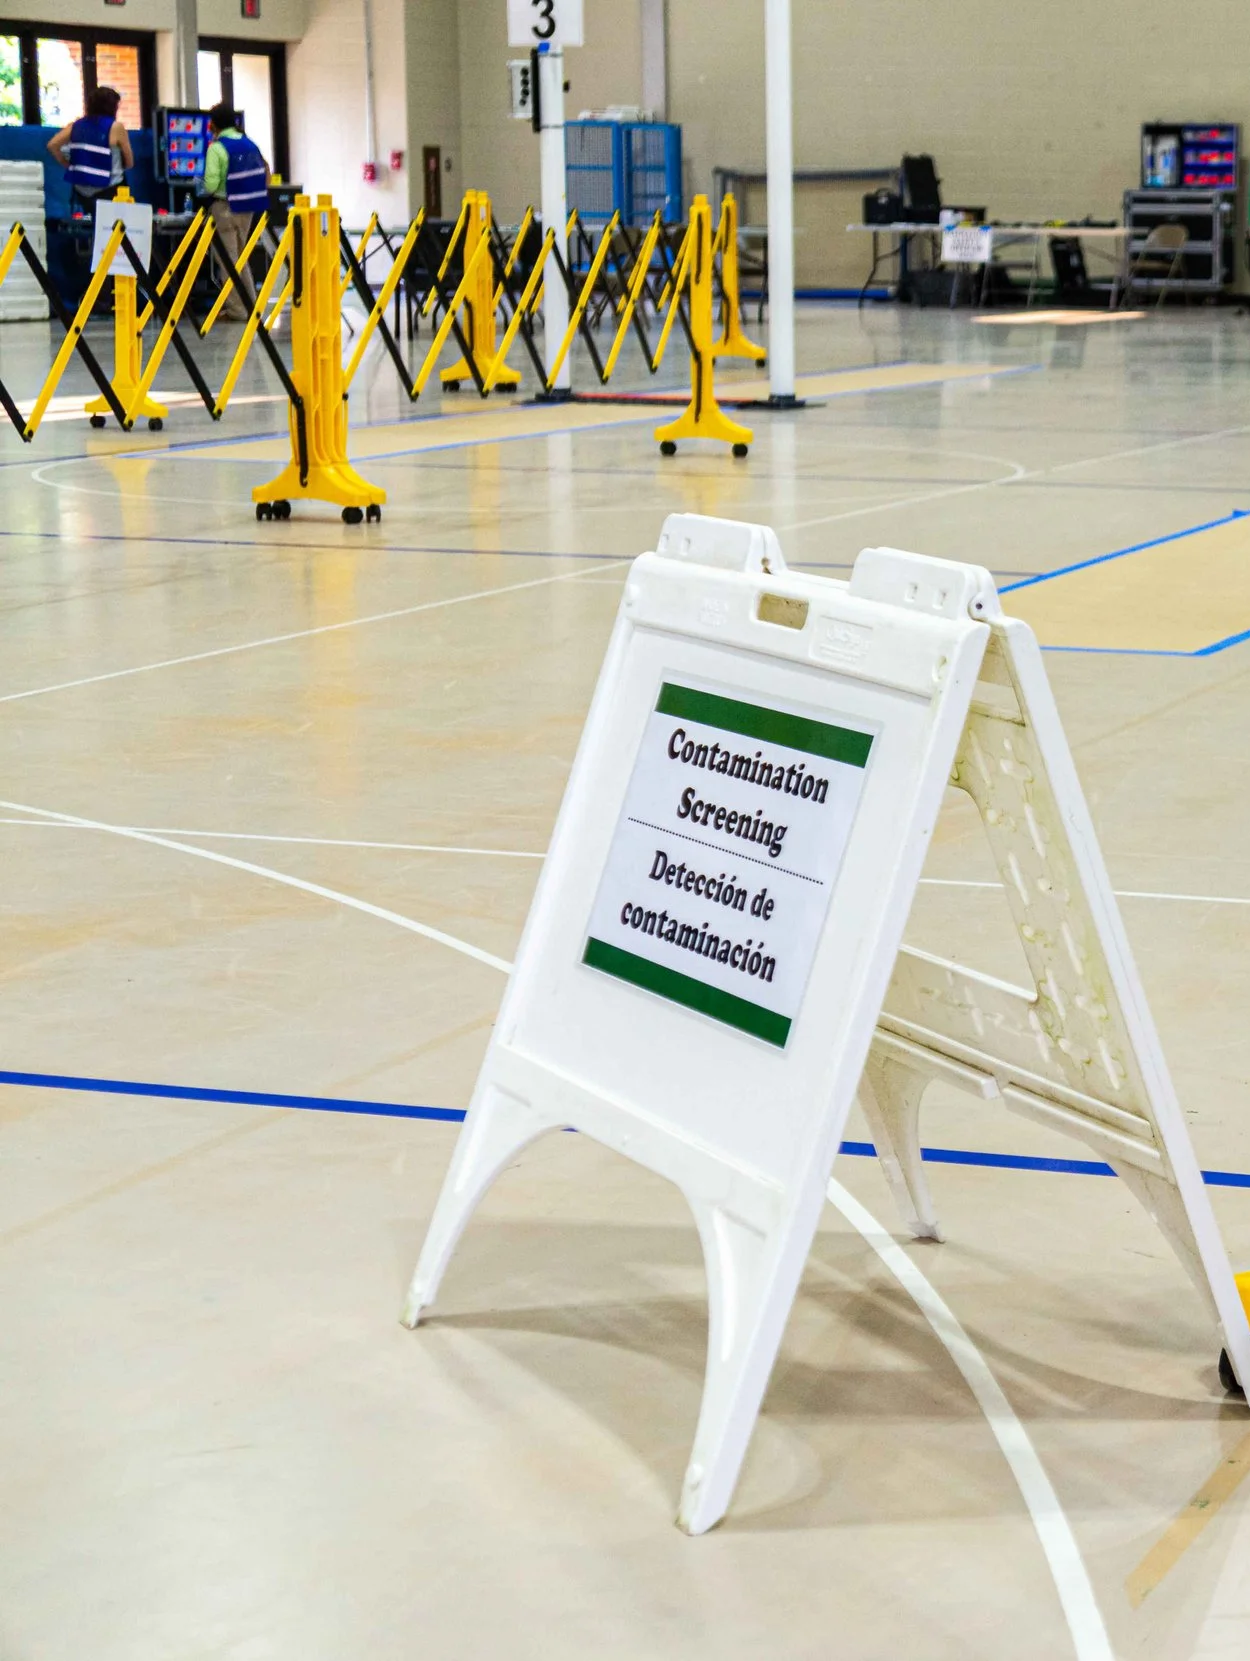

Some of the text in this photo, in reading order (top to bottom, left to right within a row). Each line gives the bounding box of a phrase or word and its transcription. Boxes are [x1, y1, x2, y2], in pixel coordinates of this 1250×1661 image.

[531, 0, 556, 39] 3
[667, 728, 829, 804] Contamination
[676, 786, 788, 858] Screening
[648, 849, 775, 921] Detección de
[620, 902, 776, 983] contaminación
